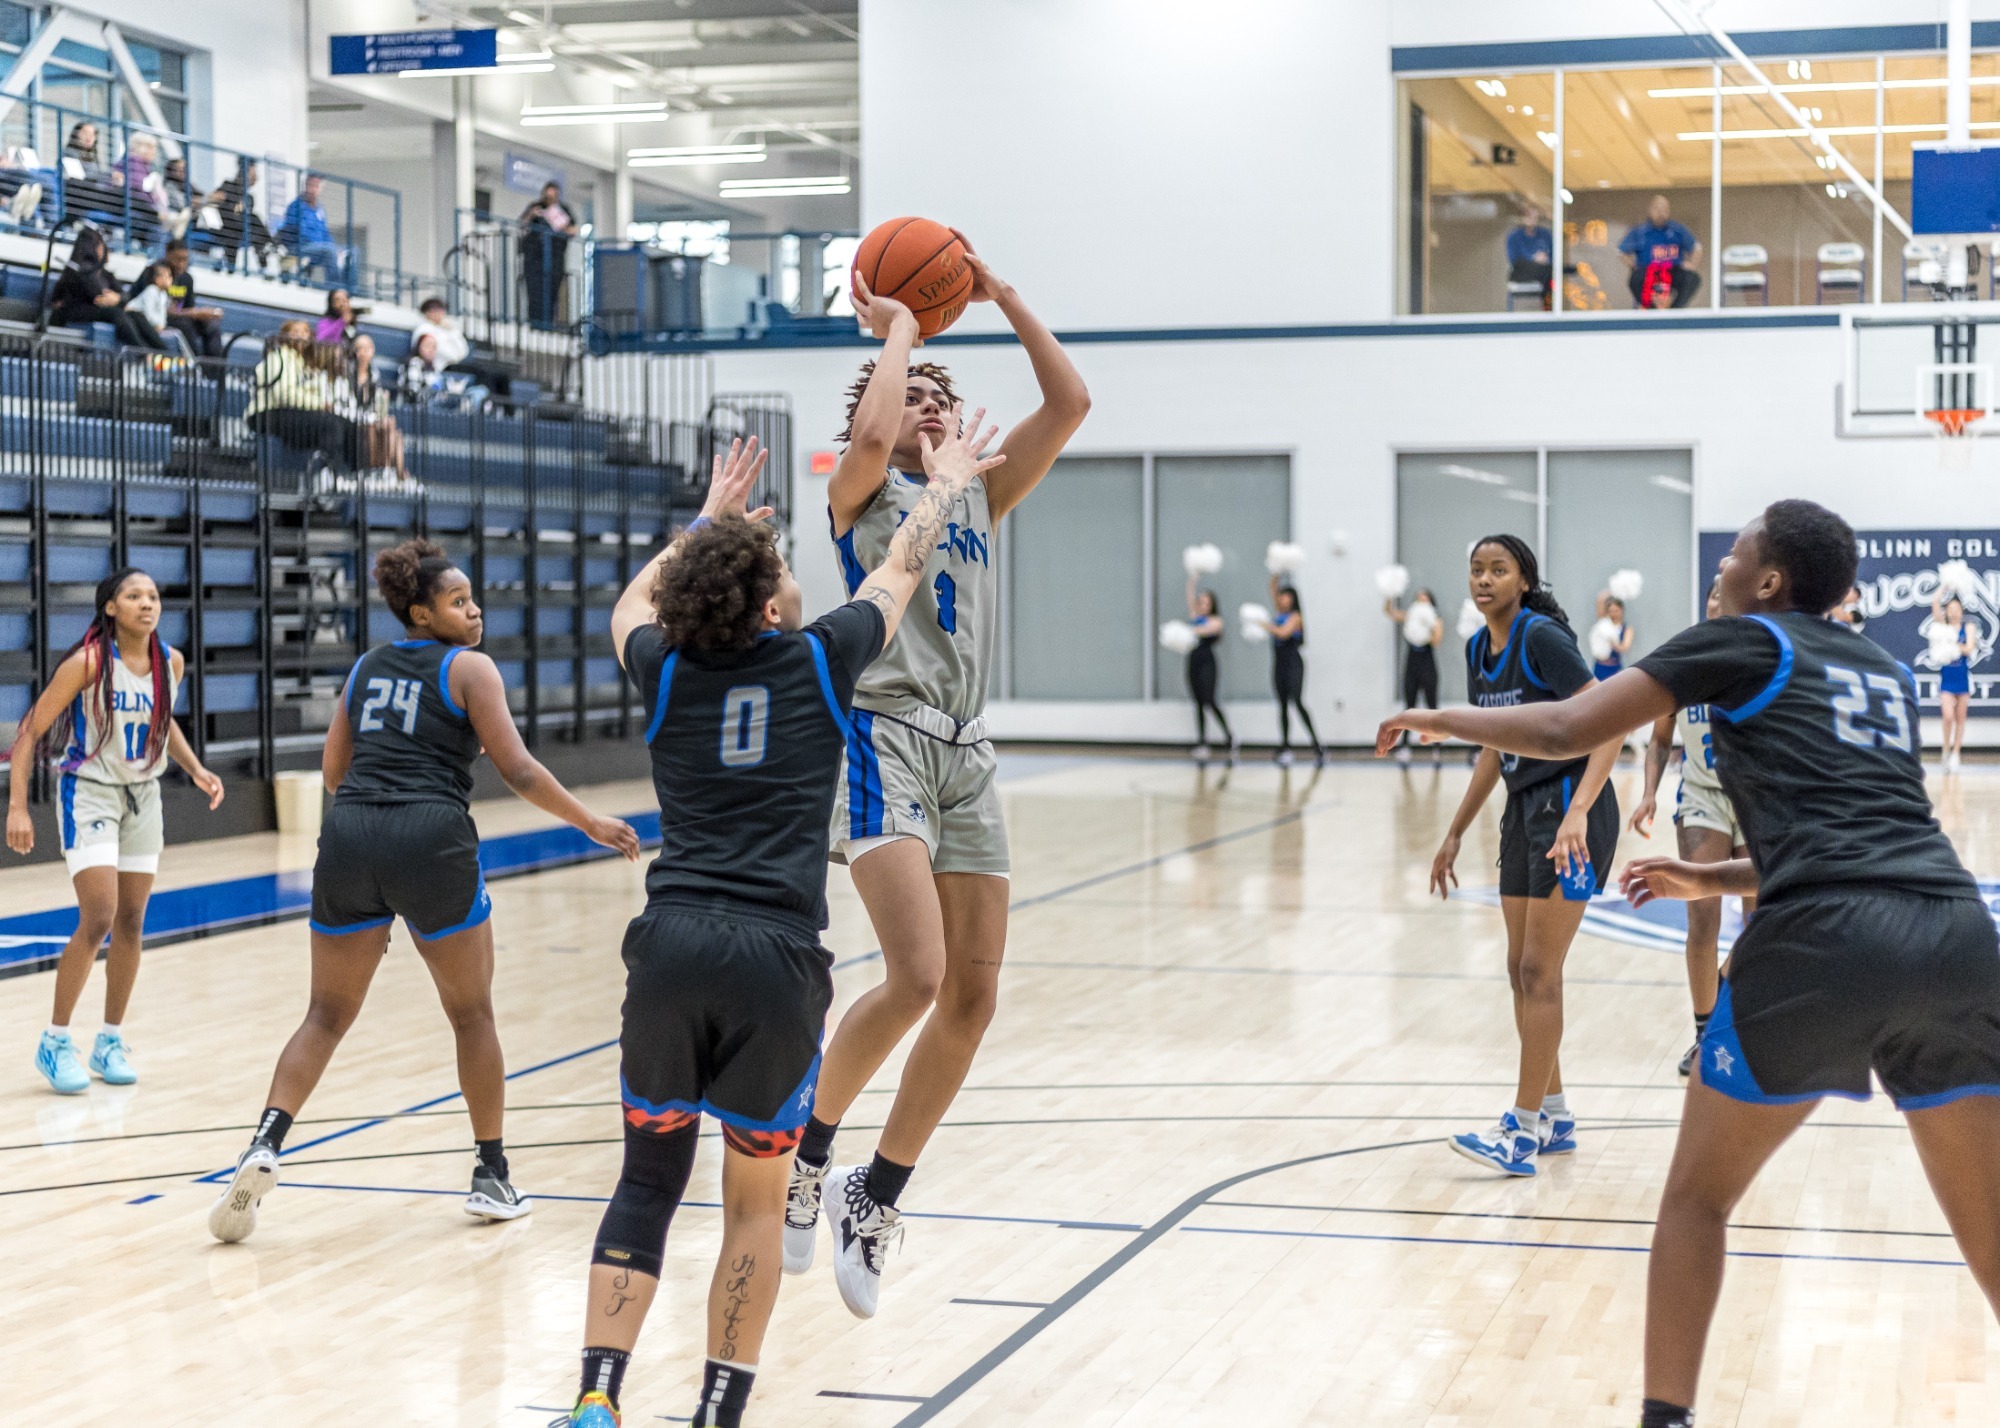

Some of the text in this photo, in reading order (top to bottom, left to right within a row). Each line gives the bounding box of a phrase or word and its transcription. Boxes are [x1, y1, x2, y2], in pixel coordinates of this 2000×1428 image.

[112, 690, 154, 712] BLIN
[359, 677, 423, 736] 24
[719, 684, 770, 767] 0
[1823, 664, 1912, 753] 23
